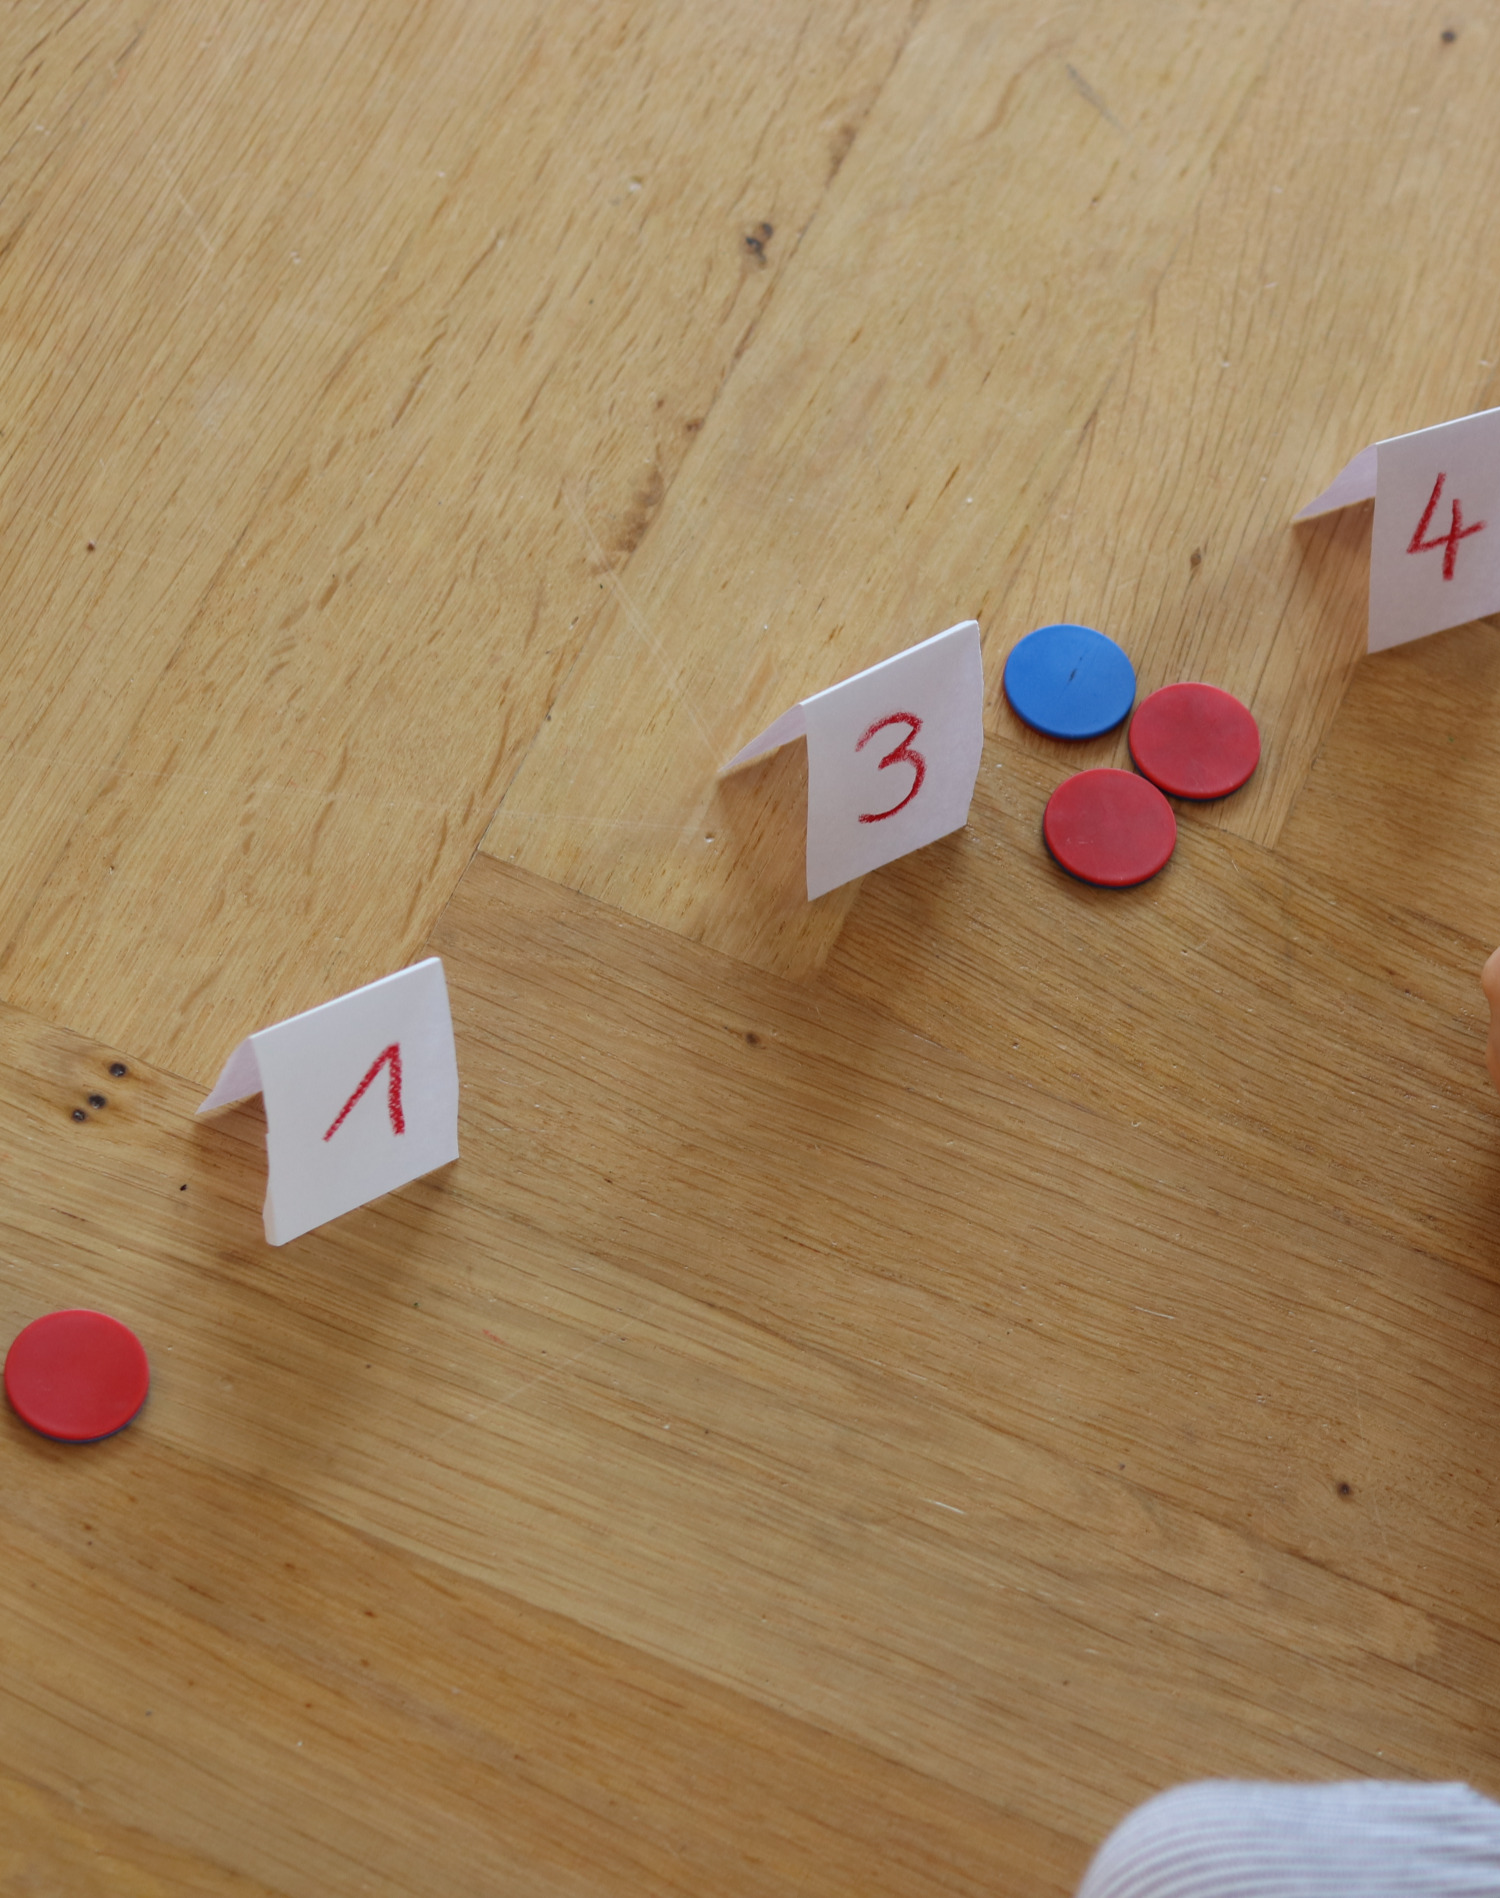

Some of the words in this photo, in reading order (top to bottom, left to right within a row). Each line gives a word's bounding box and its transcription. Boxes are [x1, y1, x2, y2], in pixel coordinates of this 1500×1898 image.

[1406, 472, 1486, 582] 4
[855, 711, 926, 824] 3
[322, 1042, 406, 1142] 1
